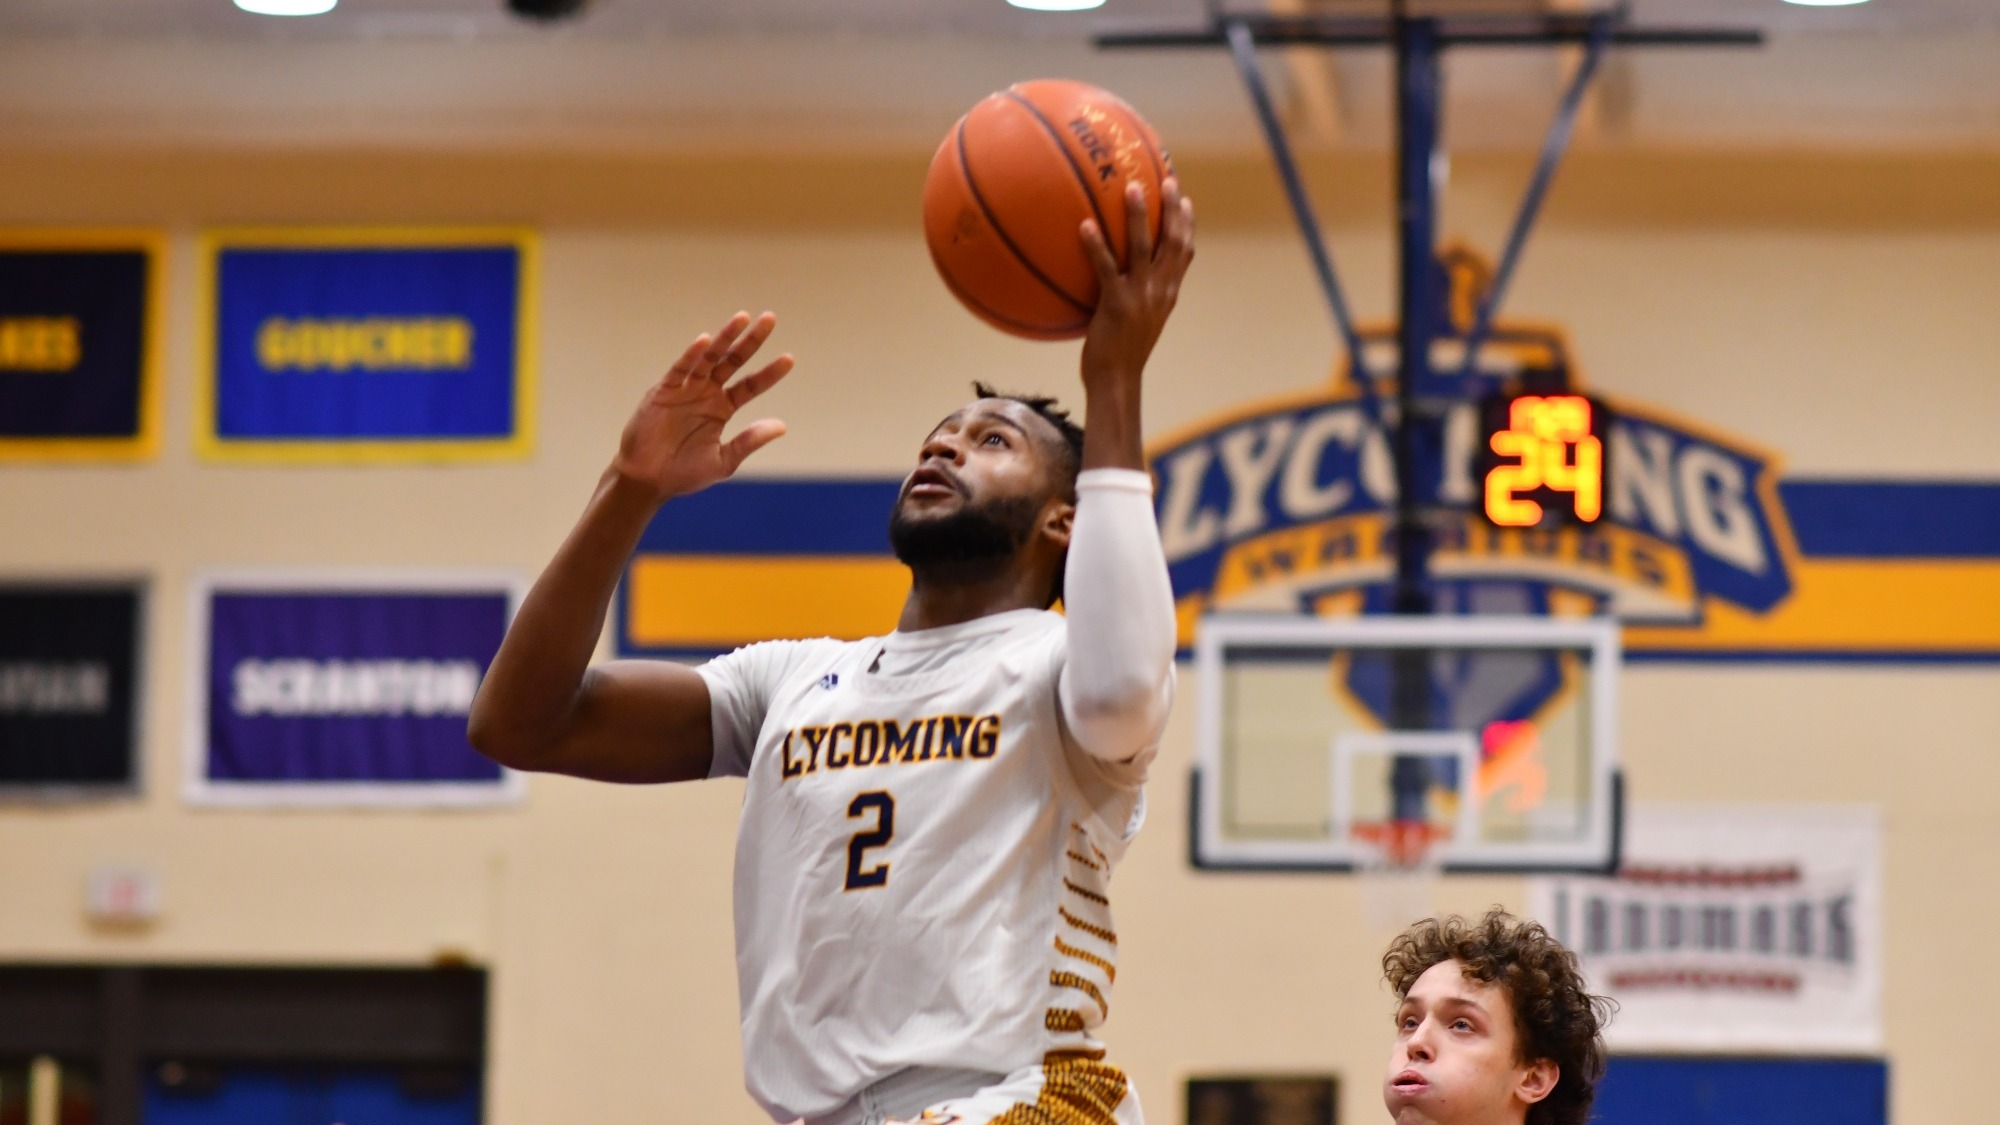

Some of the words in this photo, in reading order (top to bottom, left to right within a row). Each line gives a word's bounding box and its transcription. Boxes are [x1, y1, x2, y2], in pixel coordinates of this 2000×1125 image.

[257, 316, 473, 372] GOUCHER
[1160, 403, 1772, 576] LYCNG
[1485, 429, 1602, 526] 24
[233, 658, 481, 716] SCRANTON
[782, 713, 1000, 780] LYCOMING
[844, 789, 895, 893] 2
